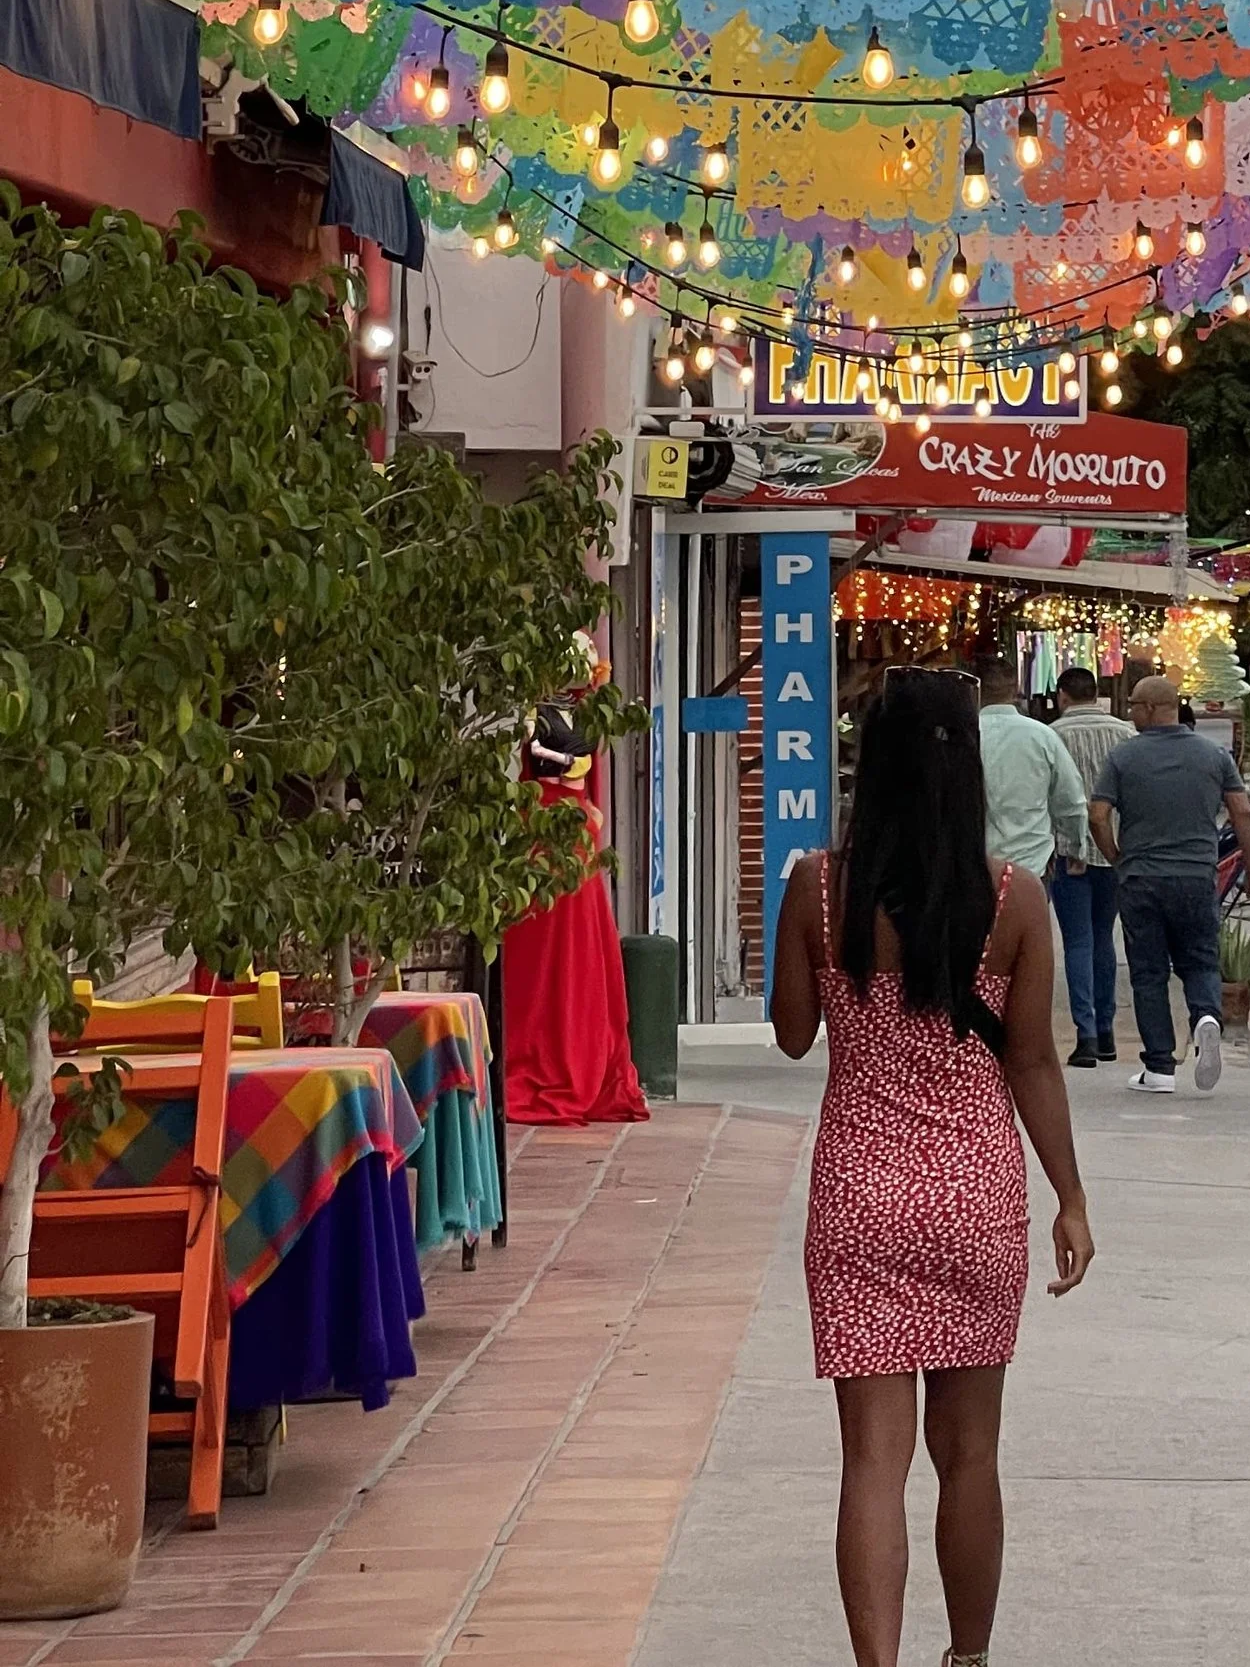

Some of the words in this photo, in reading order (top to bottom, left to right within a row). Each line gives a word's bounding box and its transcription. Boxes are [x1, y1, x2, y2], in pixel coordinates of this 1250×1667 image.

[831, 457, 900, 477] Lucas
[918, 436, 1021, 481] CRAZY
[1027, 442, 1166, 490] MOSQUITO
[764, 481, 828, 501] Mex.
[972, 486, 1042, 503] Mexican
[1045, 488, 1113, 506] Souvenirs
